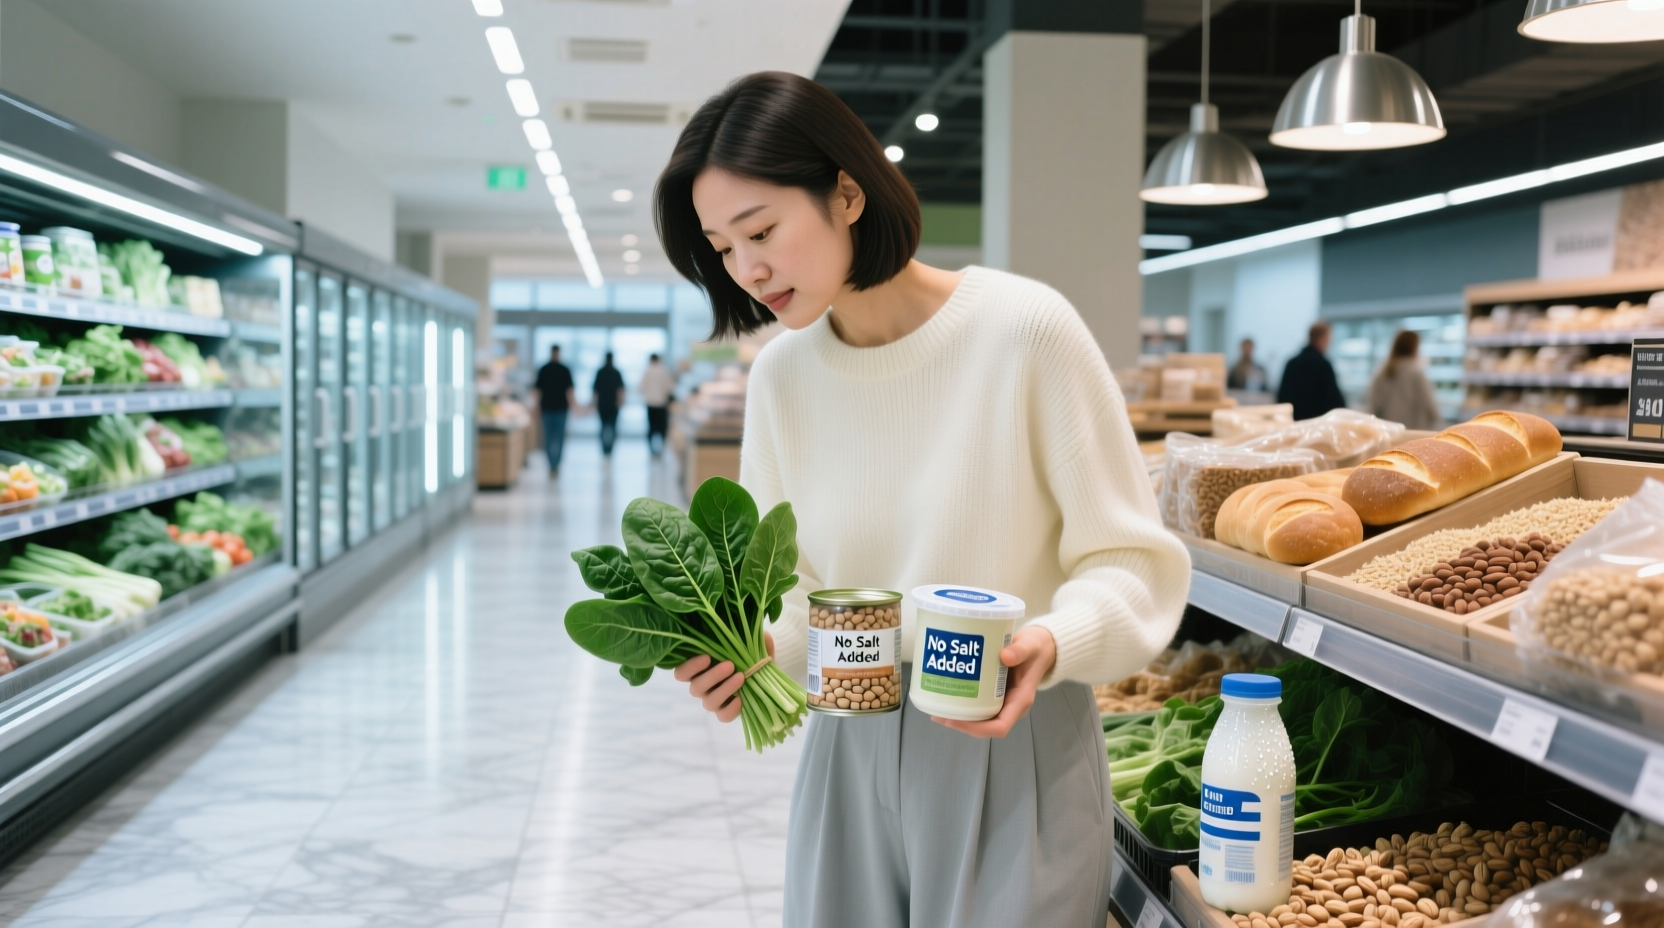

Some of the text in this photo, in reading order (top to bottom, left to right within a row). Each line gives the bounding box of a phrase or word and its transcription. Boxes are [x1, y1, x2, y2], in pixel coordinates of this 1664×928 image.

[834, 635, 880, 648] No Salt
[927, 634, 980, 656] No Salt
[837, 651, 880, 663] Added
[926, 653, 976, 674] Added
